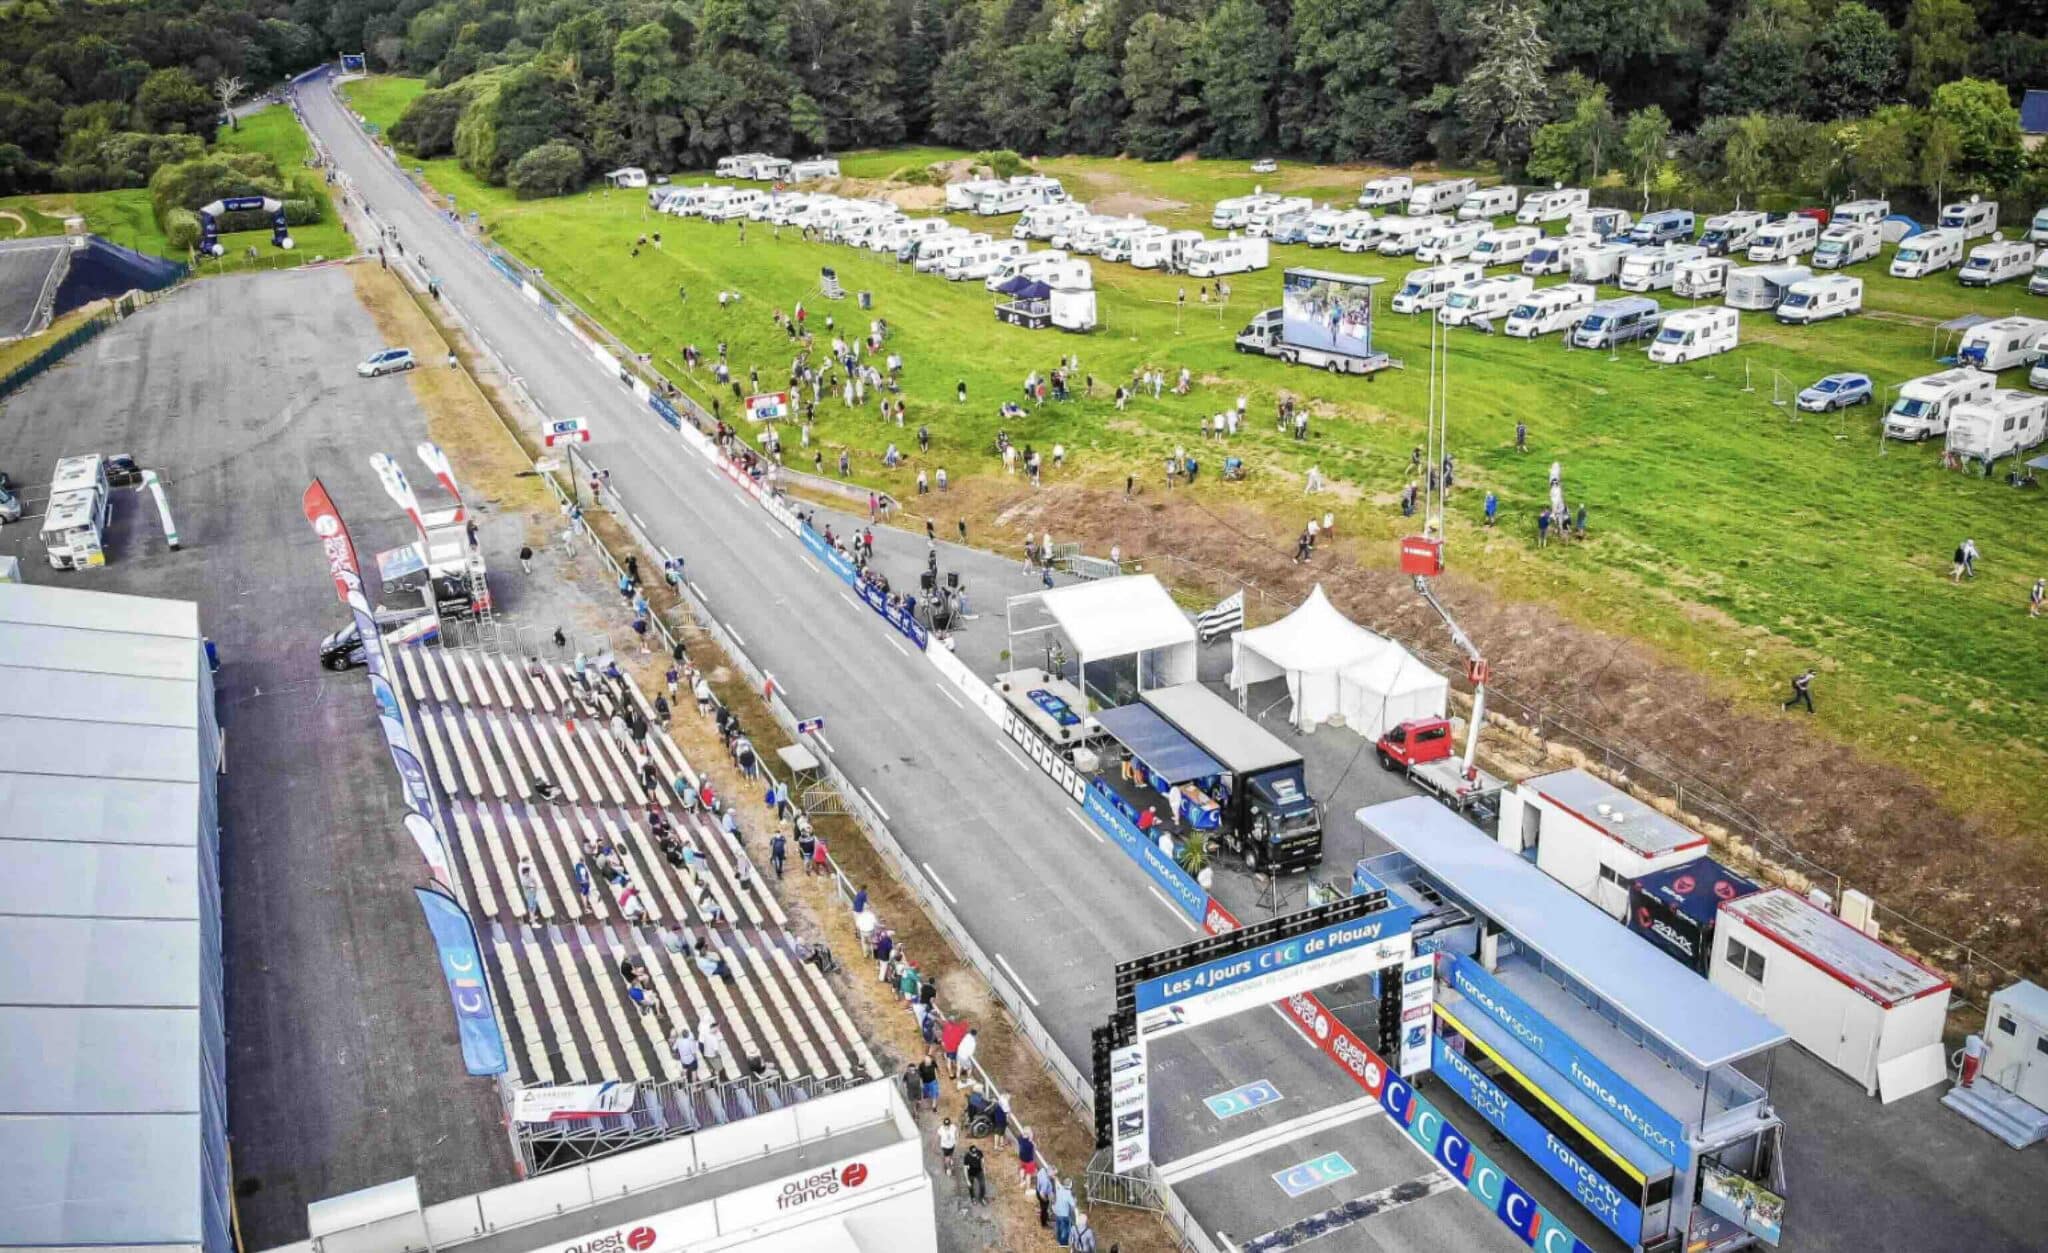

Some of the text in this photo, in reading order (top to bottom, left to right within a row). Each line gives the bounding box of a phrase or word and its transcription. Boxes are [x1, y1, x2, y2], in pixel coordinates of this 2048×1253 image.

[1163, 977, 1191, 998] Les
[1194, 973, 1204, 986] 4
[1208, 960, 1251, 987] Jours
[1259, 945, 1297, 968] CIC
[1304, 937, 1324, 954] de
[1328, 921, 1382, 947] Plouay
[451, 953, 482, 1012] CIC
[1471, 1086, 1506, 1127] sport
[1387, 1081, 1437, 1143] CIC
[1443, 1135, 1498, 1200] CIC
[782, 1167, 839, 1196] ouest
[1286, 1158, 1347, 1188] CIC
[776, 1181, 840, 1210] france
[1577, 1180, 1619, 1225] sport
